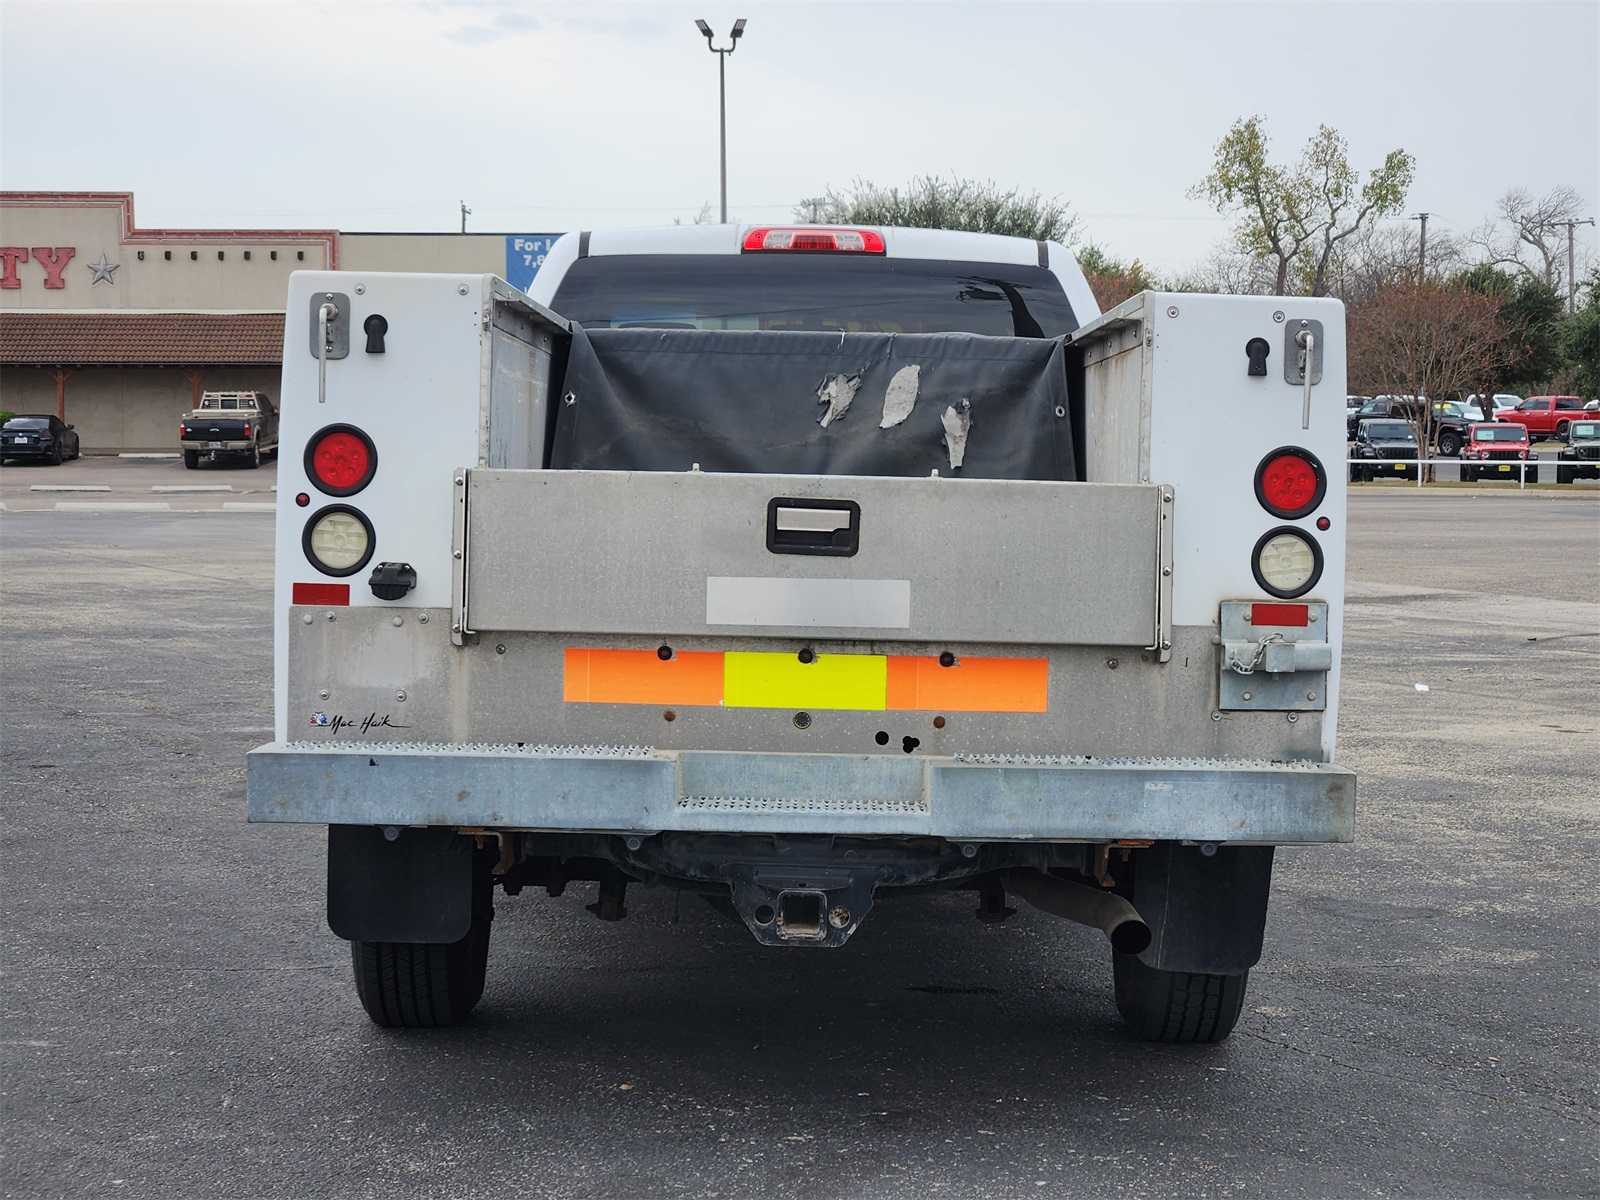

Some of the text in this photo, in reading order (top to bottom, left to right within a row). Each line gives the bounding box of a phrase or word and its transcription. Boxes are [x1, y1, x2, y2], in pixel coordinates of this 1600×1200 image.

[514, 238, 541, 251] For
[328, 712, 411, 735] Mac Haik
